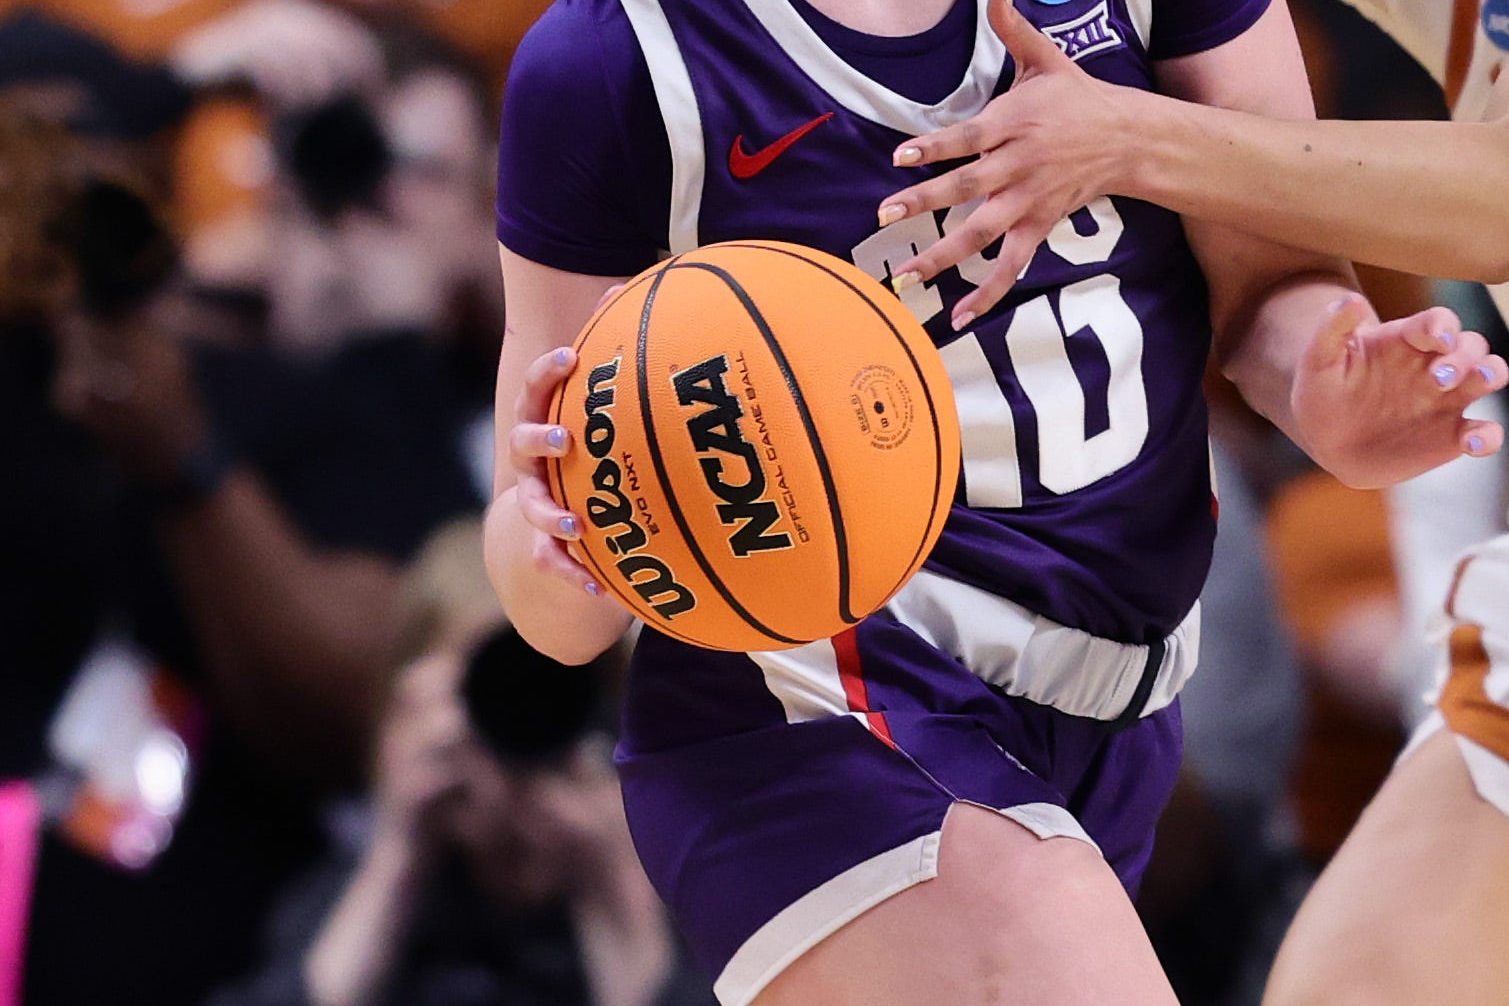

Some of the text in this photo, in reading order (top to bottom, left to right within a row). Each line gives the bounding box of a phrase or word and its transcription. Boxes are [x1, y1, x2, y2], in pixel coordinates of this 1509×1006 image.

[583, 355, 697, 622] Wilson
[622, 451, 660, 535] EVO NXT
[671, 352, 793, 559] NCAA
[734, 350, 810, 544] OFFICIAL GAME BALL
[937, 273, 1150, 509] 10
